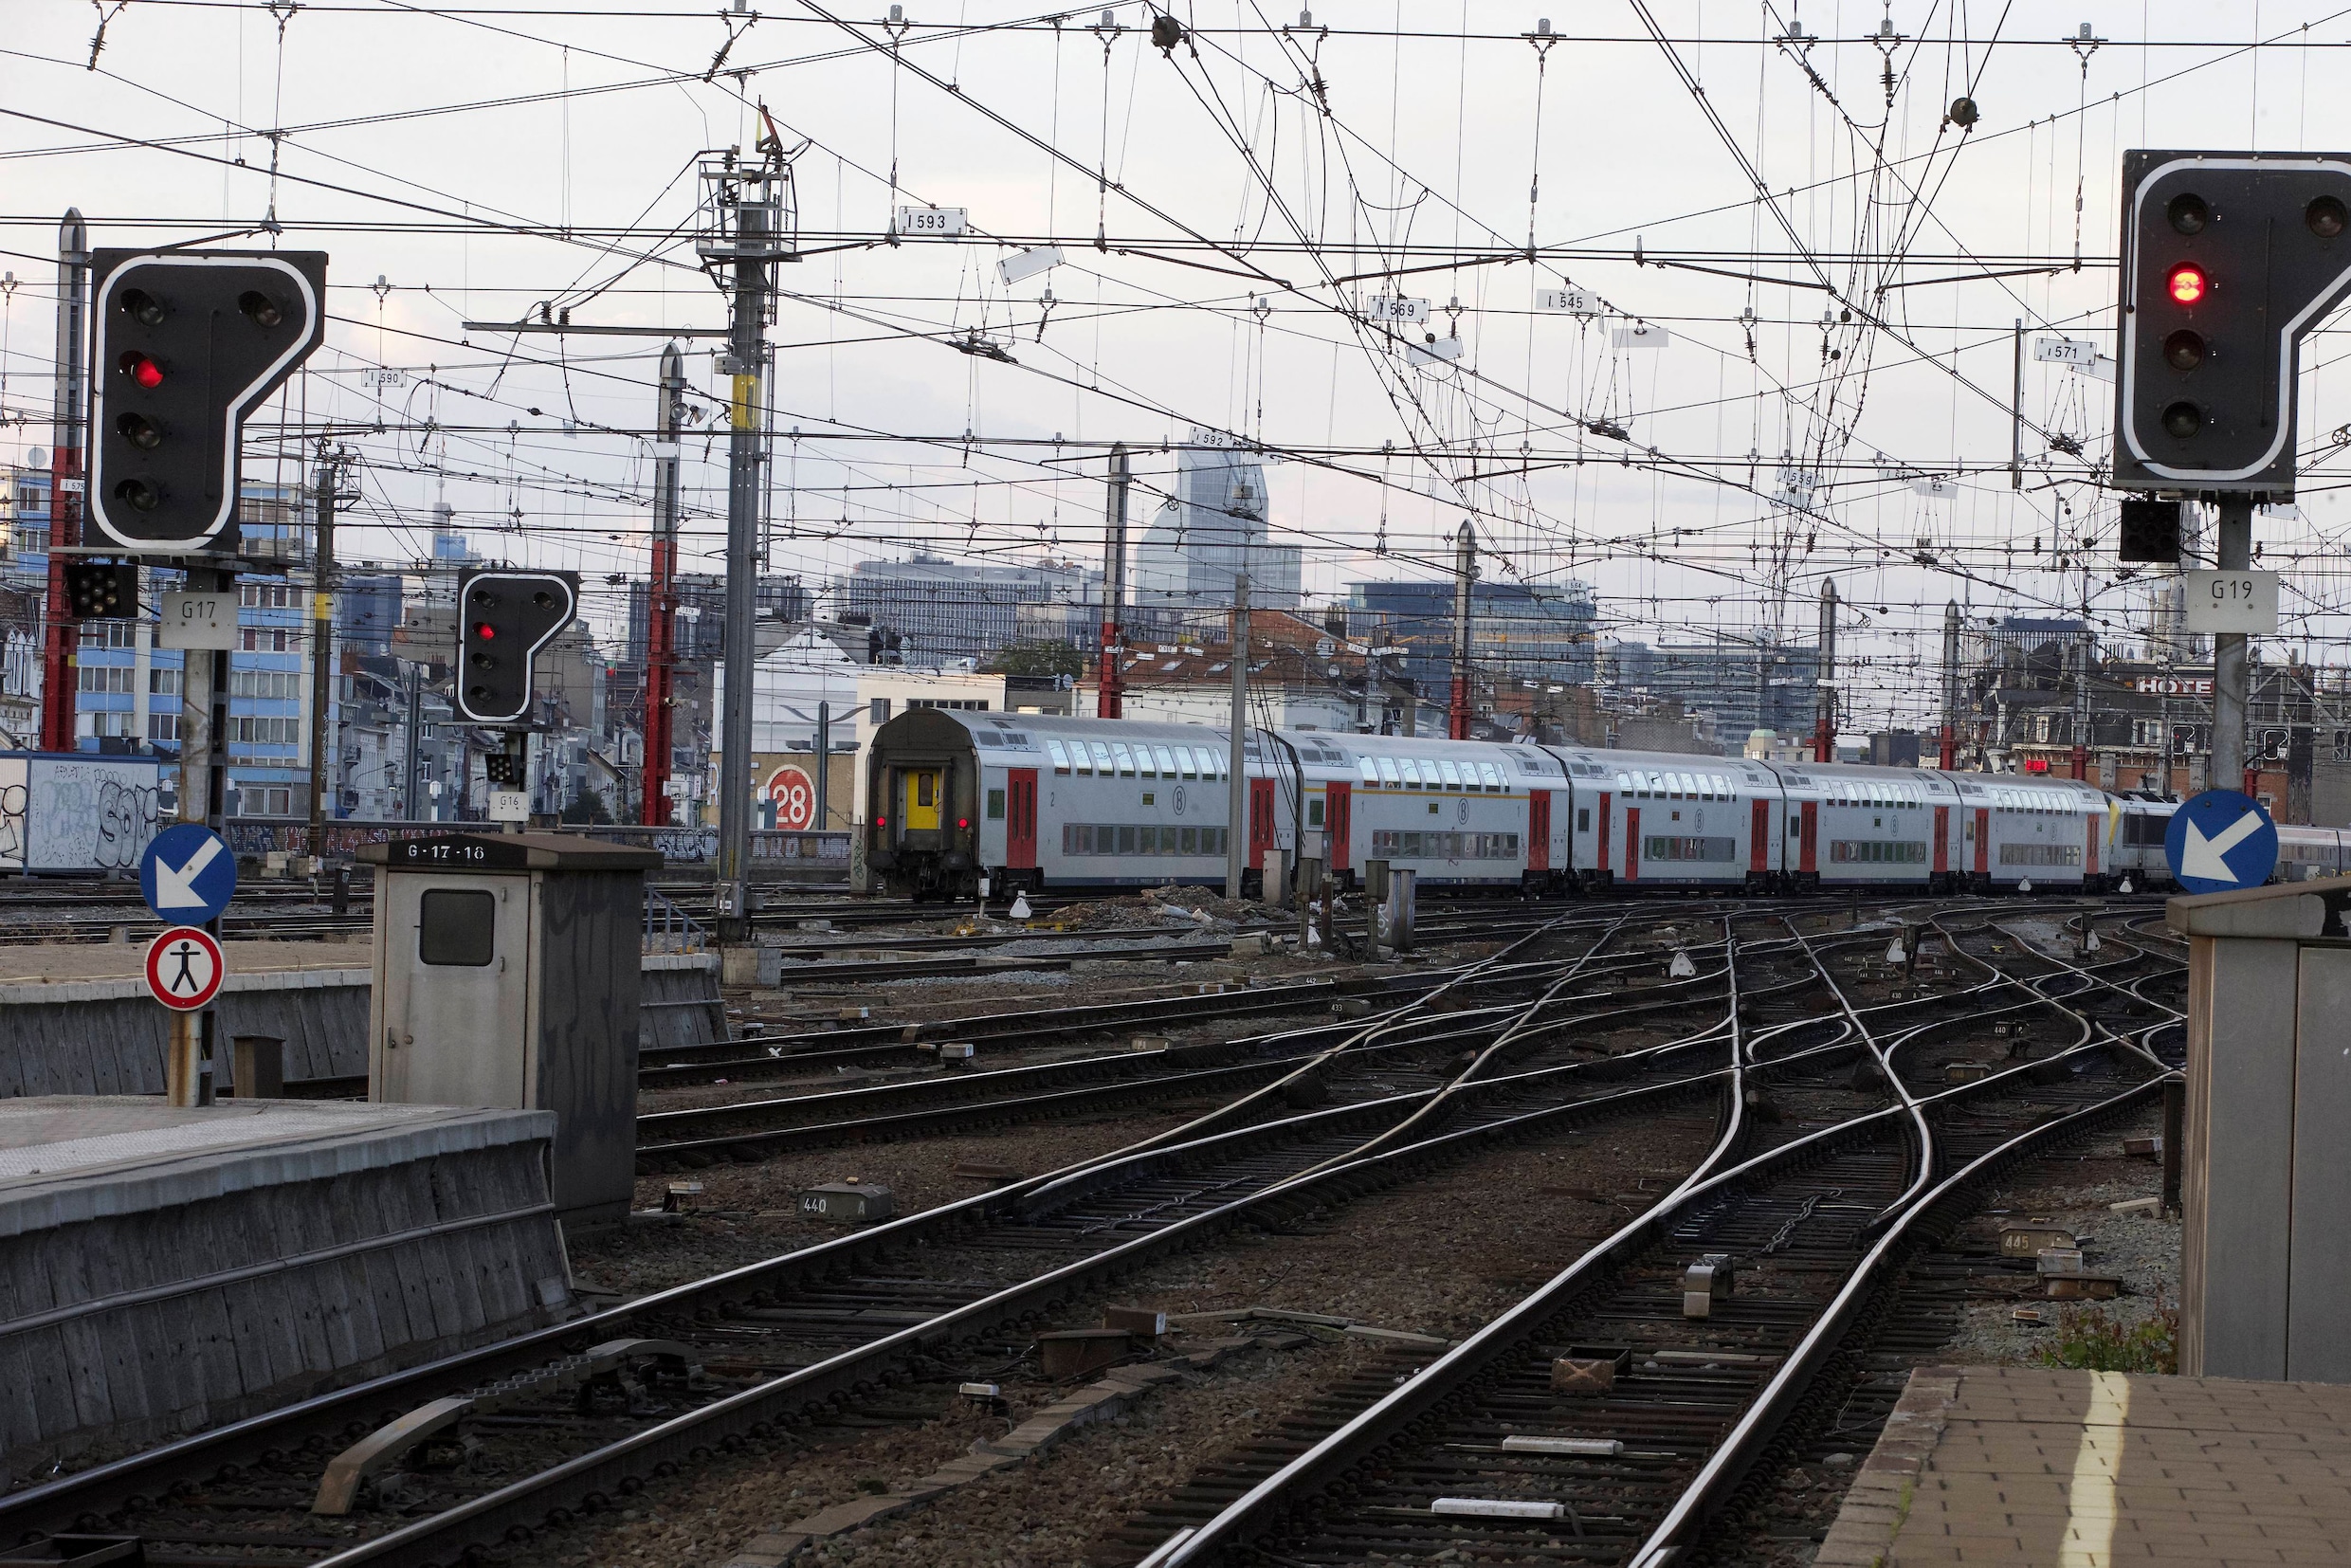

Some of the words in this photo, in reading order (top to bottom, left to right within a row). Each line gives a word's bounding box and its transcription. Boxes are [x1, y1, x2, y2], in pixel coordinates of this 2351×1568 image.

[918, 214, 945, 228] 593
[1390, 302, 1414, 317] 569
[1559, 296, 1583, 309] 545
[2054, 346, 2078, 358] 571
[380, 373, 399, 384] 590
[1203, 434, 1224, 447] 592
[2212, 579, 2252, 600] G19
[182, 601, 216, 619] G17
[2139, 679, 2213, 694] HOTE
[501, 795, 519, 806] G16
[773, 784, 807, 824] 28
[1049, 791, 1055, 807] 2
[1331, 1003, 1343, 1012] 433
[1994, 1026, 2007, 1034] 440
[804, 1197, 827, 1213] 440
[857, 1200, 866, 1214] A
[2005, 1234, 2029, 1249] 445
